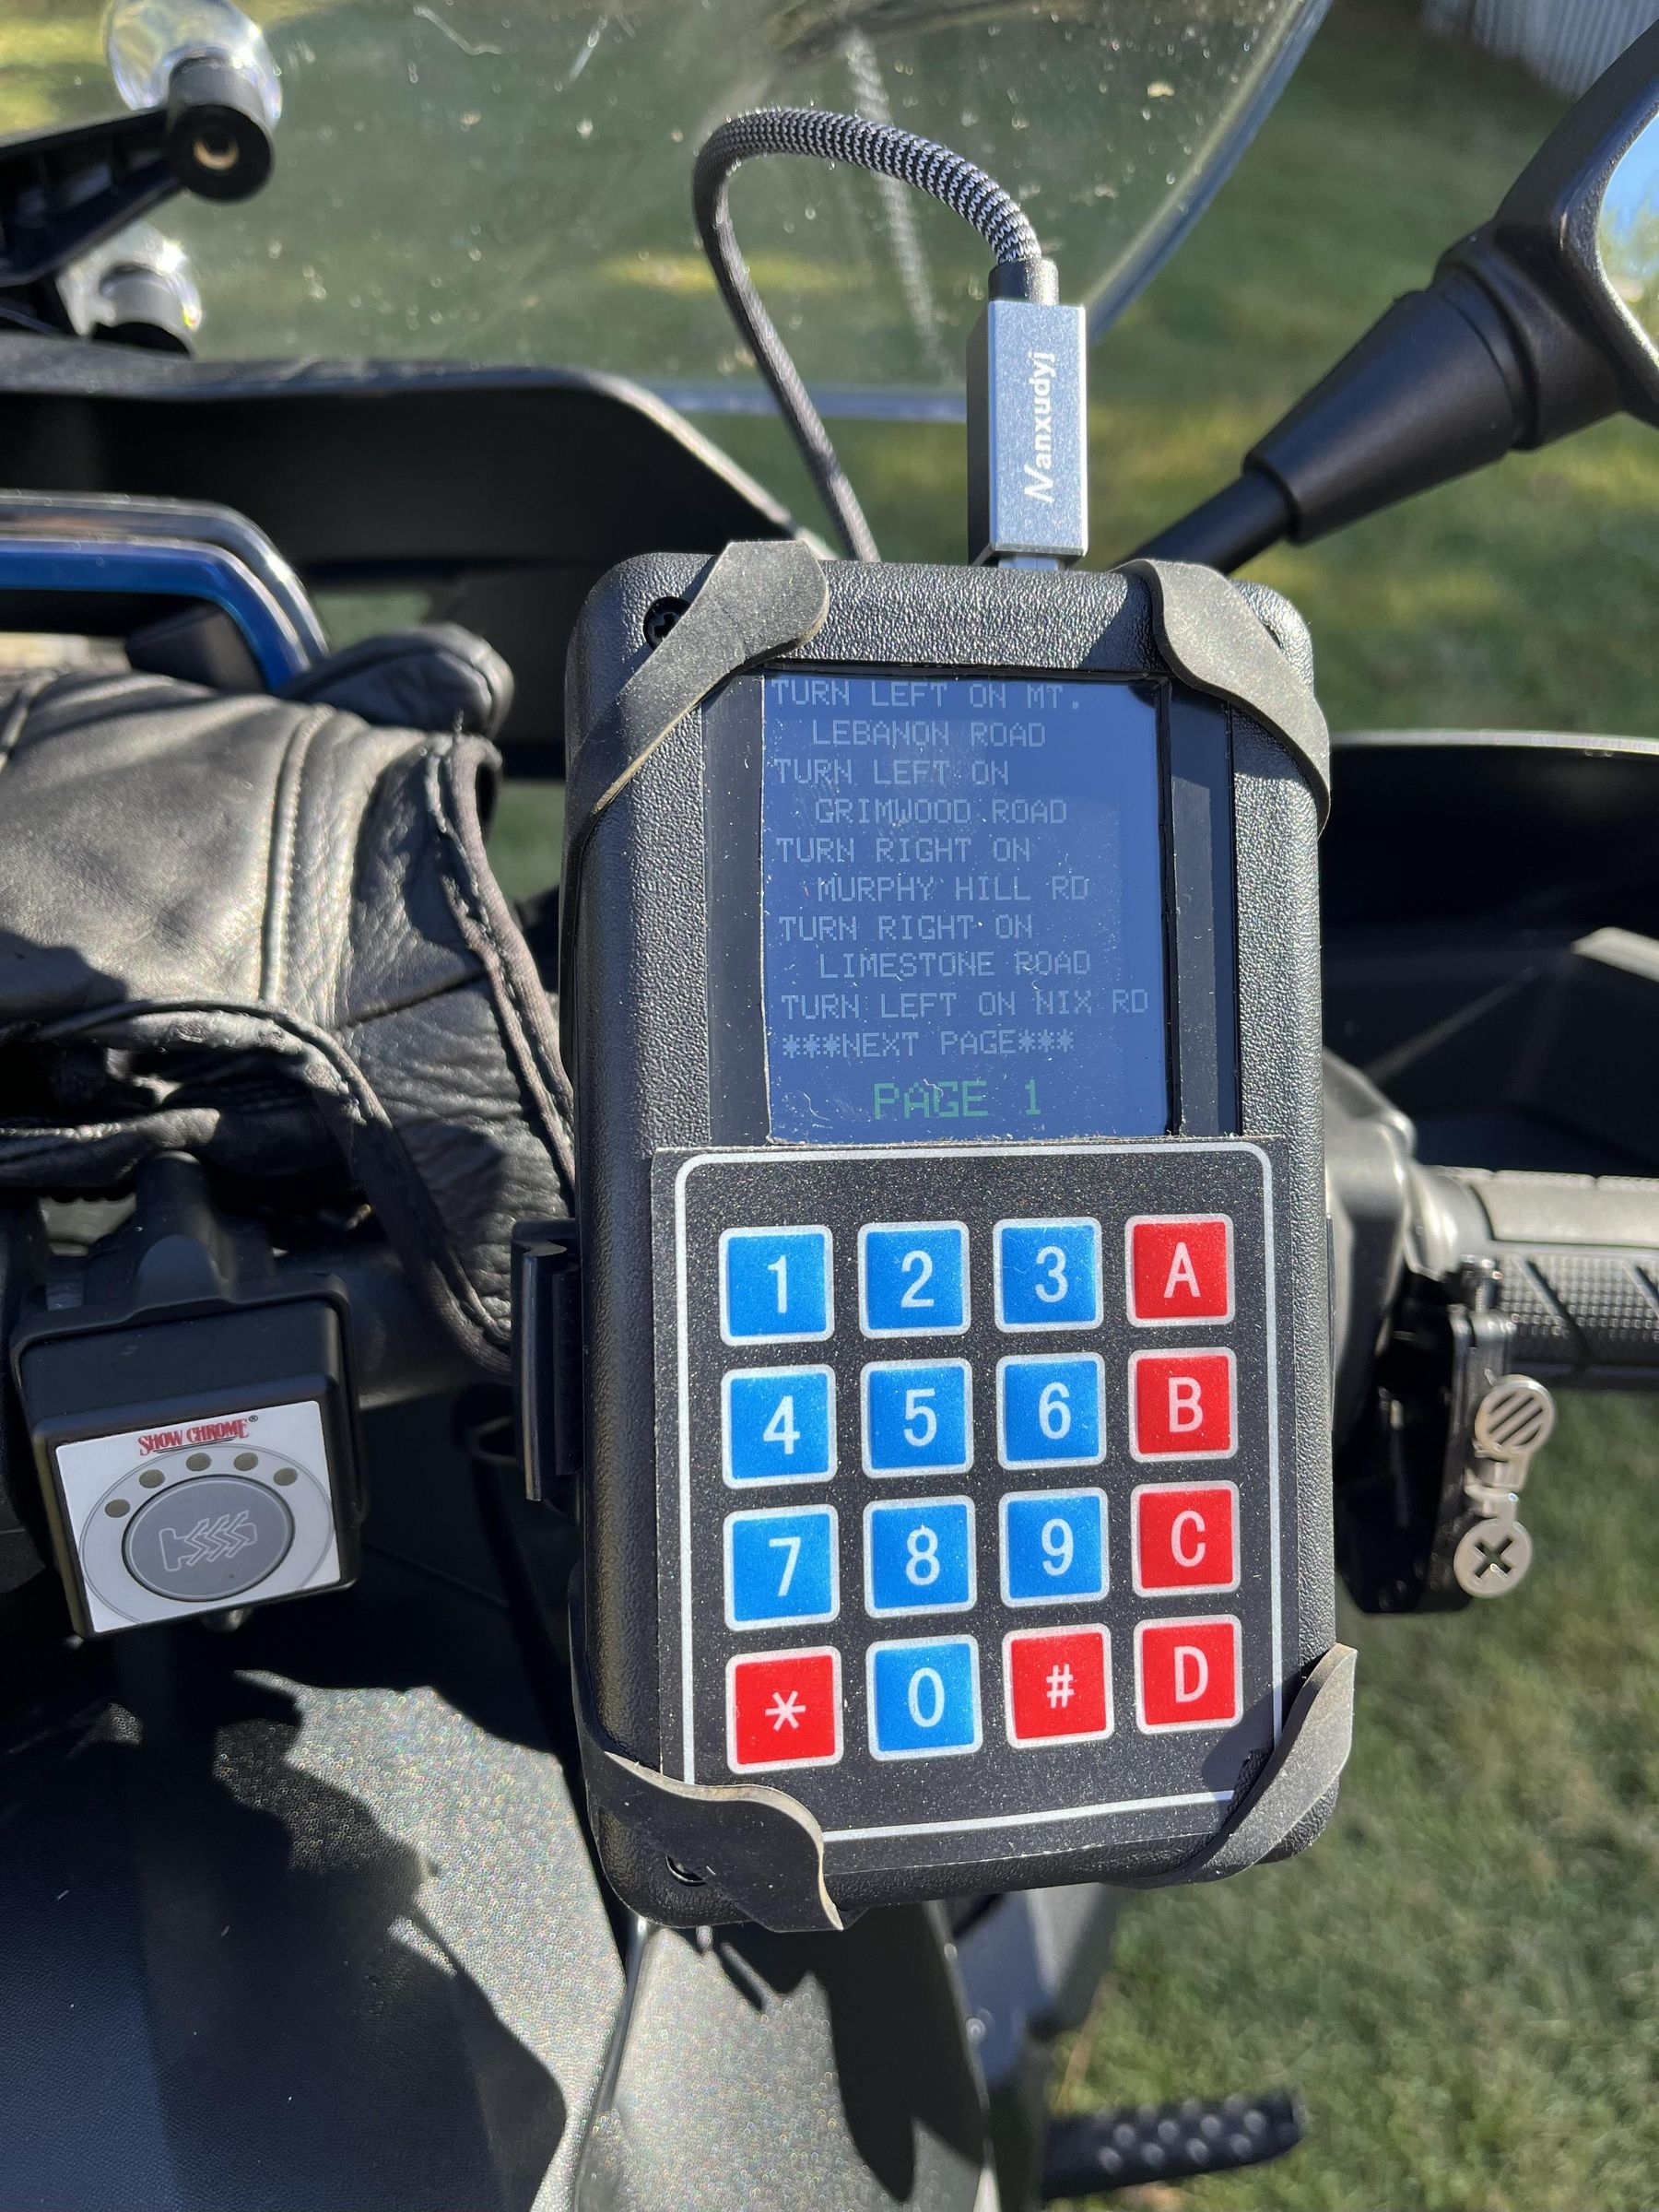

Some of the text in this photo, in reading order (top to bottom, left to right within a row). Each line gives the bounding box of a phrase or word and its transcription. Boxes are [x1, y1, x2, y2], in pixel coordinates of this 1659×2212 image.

[771, 679, 1079, 710] TURN LEFT ON MT.
[813, 720, 1046, 747] LEBANON ROAD
[774, 759, 1008, 785] TURN LEFT ON
[815, 798, 1067, 824] GRIMWOOD ROAD
[776, 837, 1030, 863] TURN RIGHT ON
[818, 876, 1088, 902] MURPHY HILL RD
[779, 914, 1033, 941] TURN RIGHT ON
[820, 950, 1090, 979] LIMESTONE ROAD
[781, 989, 1148, 1019] TURN LEFT ON NIX RD
[874, 1079, 1041, 1120] PAGE 1
[769, 1241, 1201, 1314] 1 2 3 A
[762, 1376, 1204, 1455] 4 5 6 B
[138, 1430, 182, 1456] SHOW
[769, 1510, 1206, 1597] 7 8 9 C
[908, 1667, 945, 1727] 0
[1046, 1664, 1076, 1709] #
[1174, 1646, 1208, 1703] D
